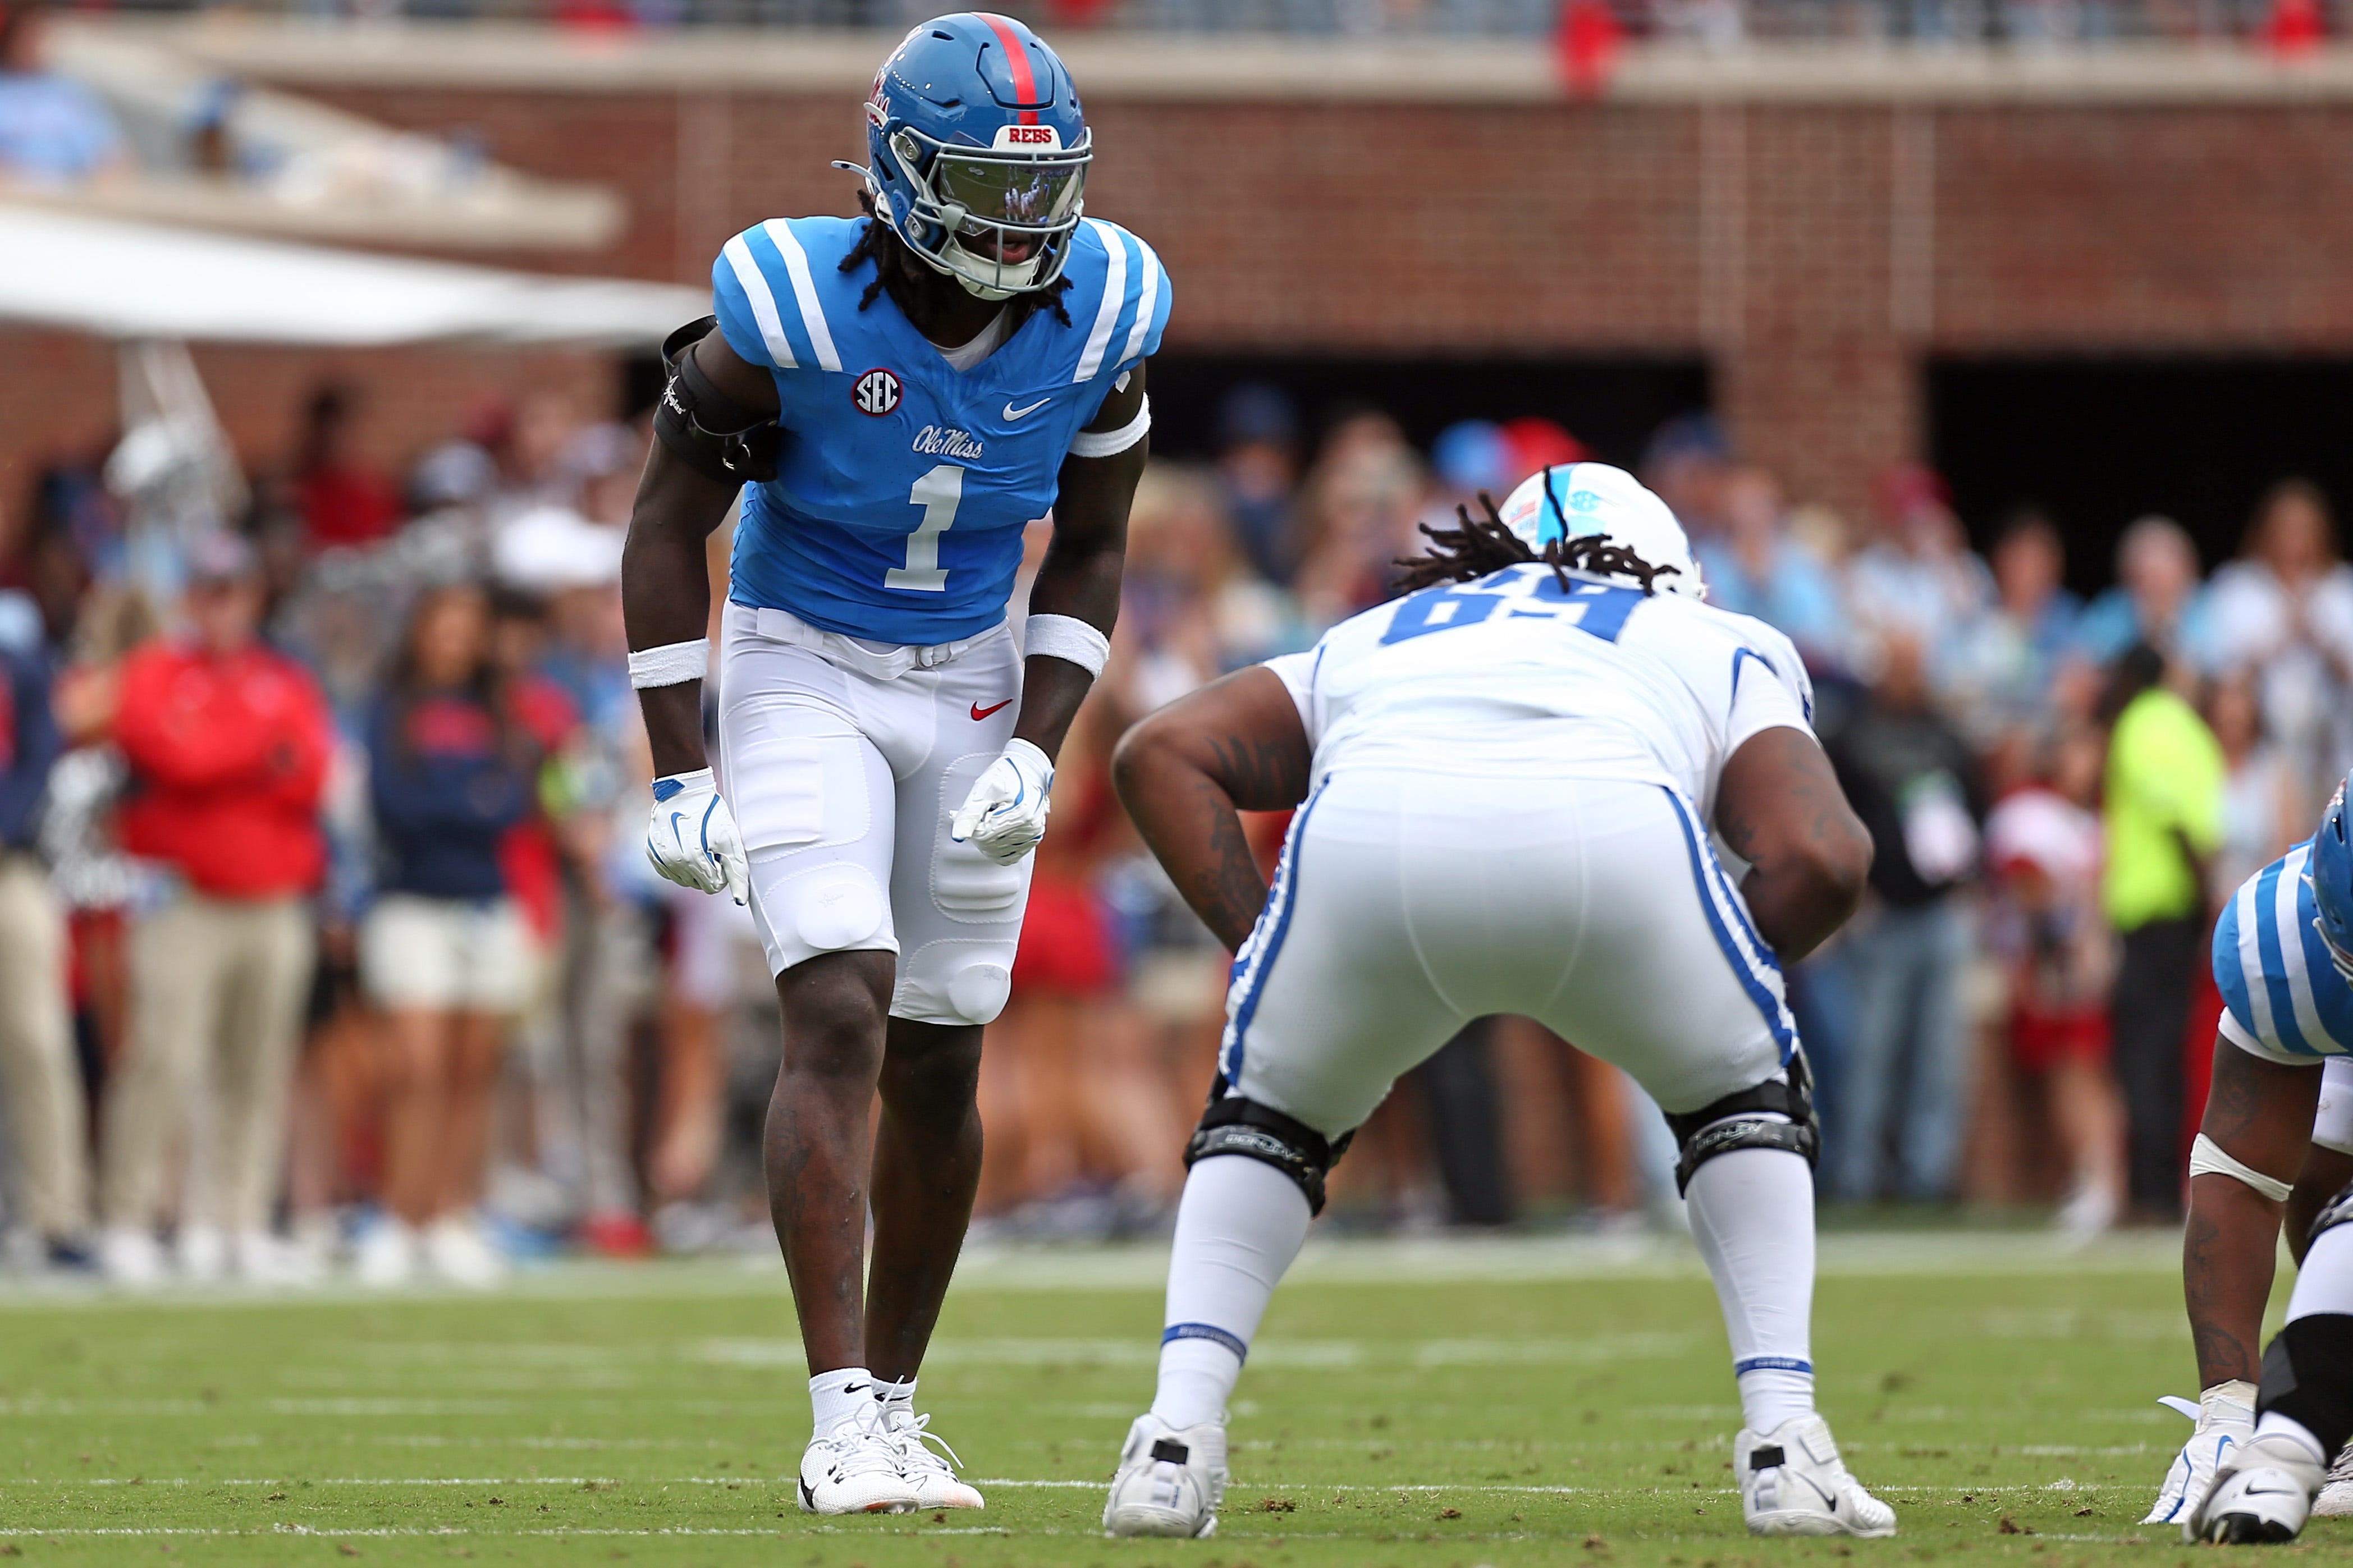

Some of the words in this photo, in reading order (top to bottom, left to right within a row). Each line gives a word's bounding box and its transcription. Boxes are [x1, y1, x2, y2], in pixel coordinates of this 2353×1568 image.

[1009, 128, 1052, 143] REBS
[857, 372, 898, 413] SEC
[912, 425, 943, 455] Ole
[940, 429, 983, 459] Miss
[884, 465, 965, 592] 1
[1379, 567, 1646, 646] 69
